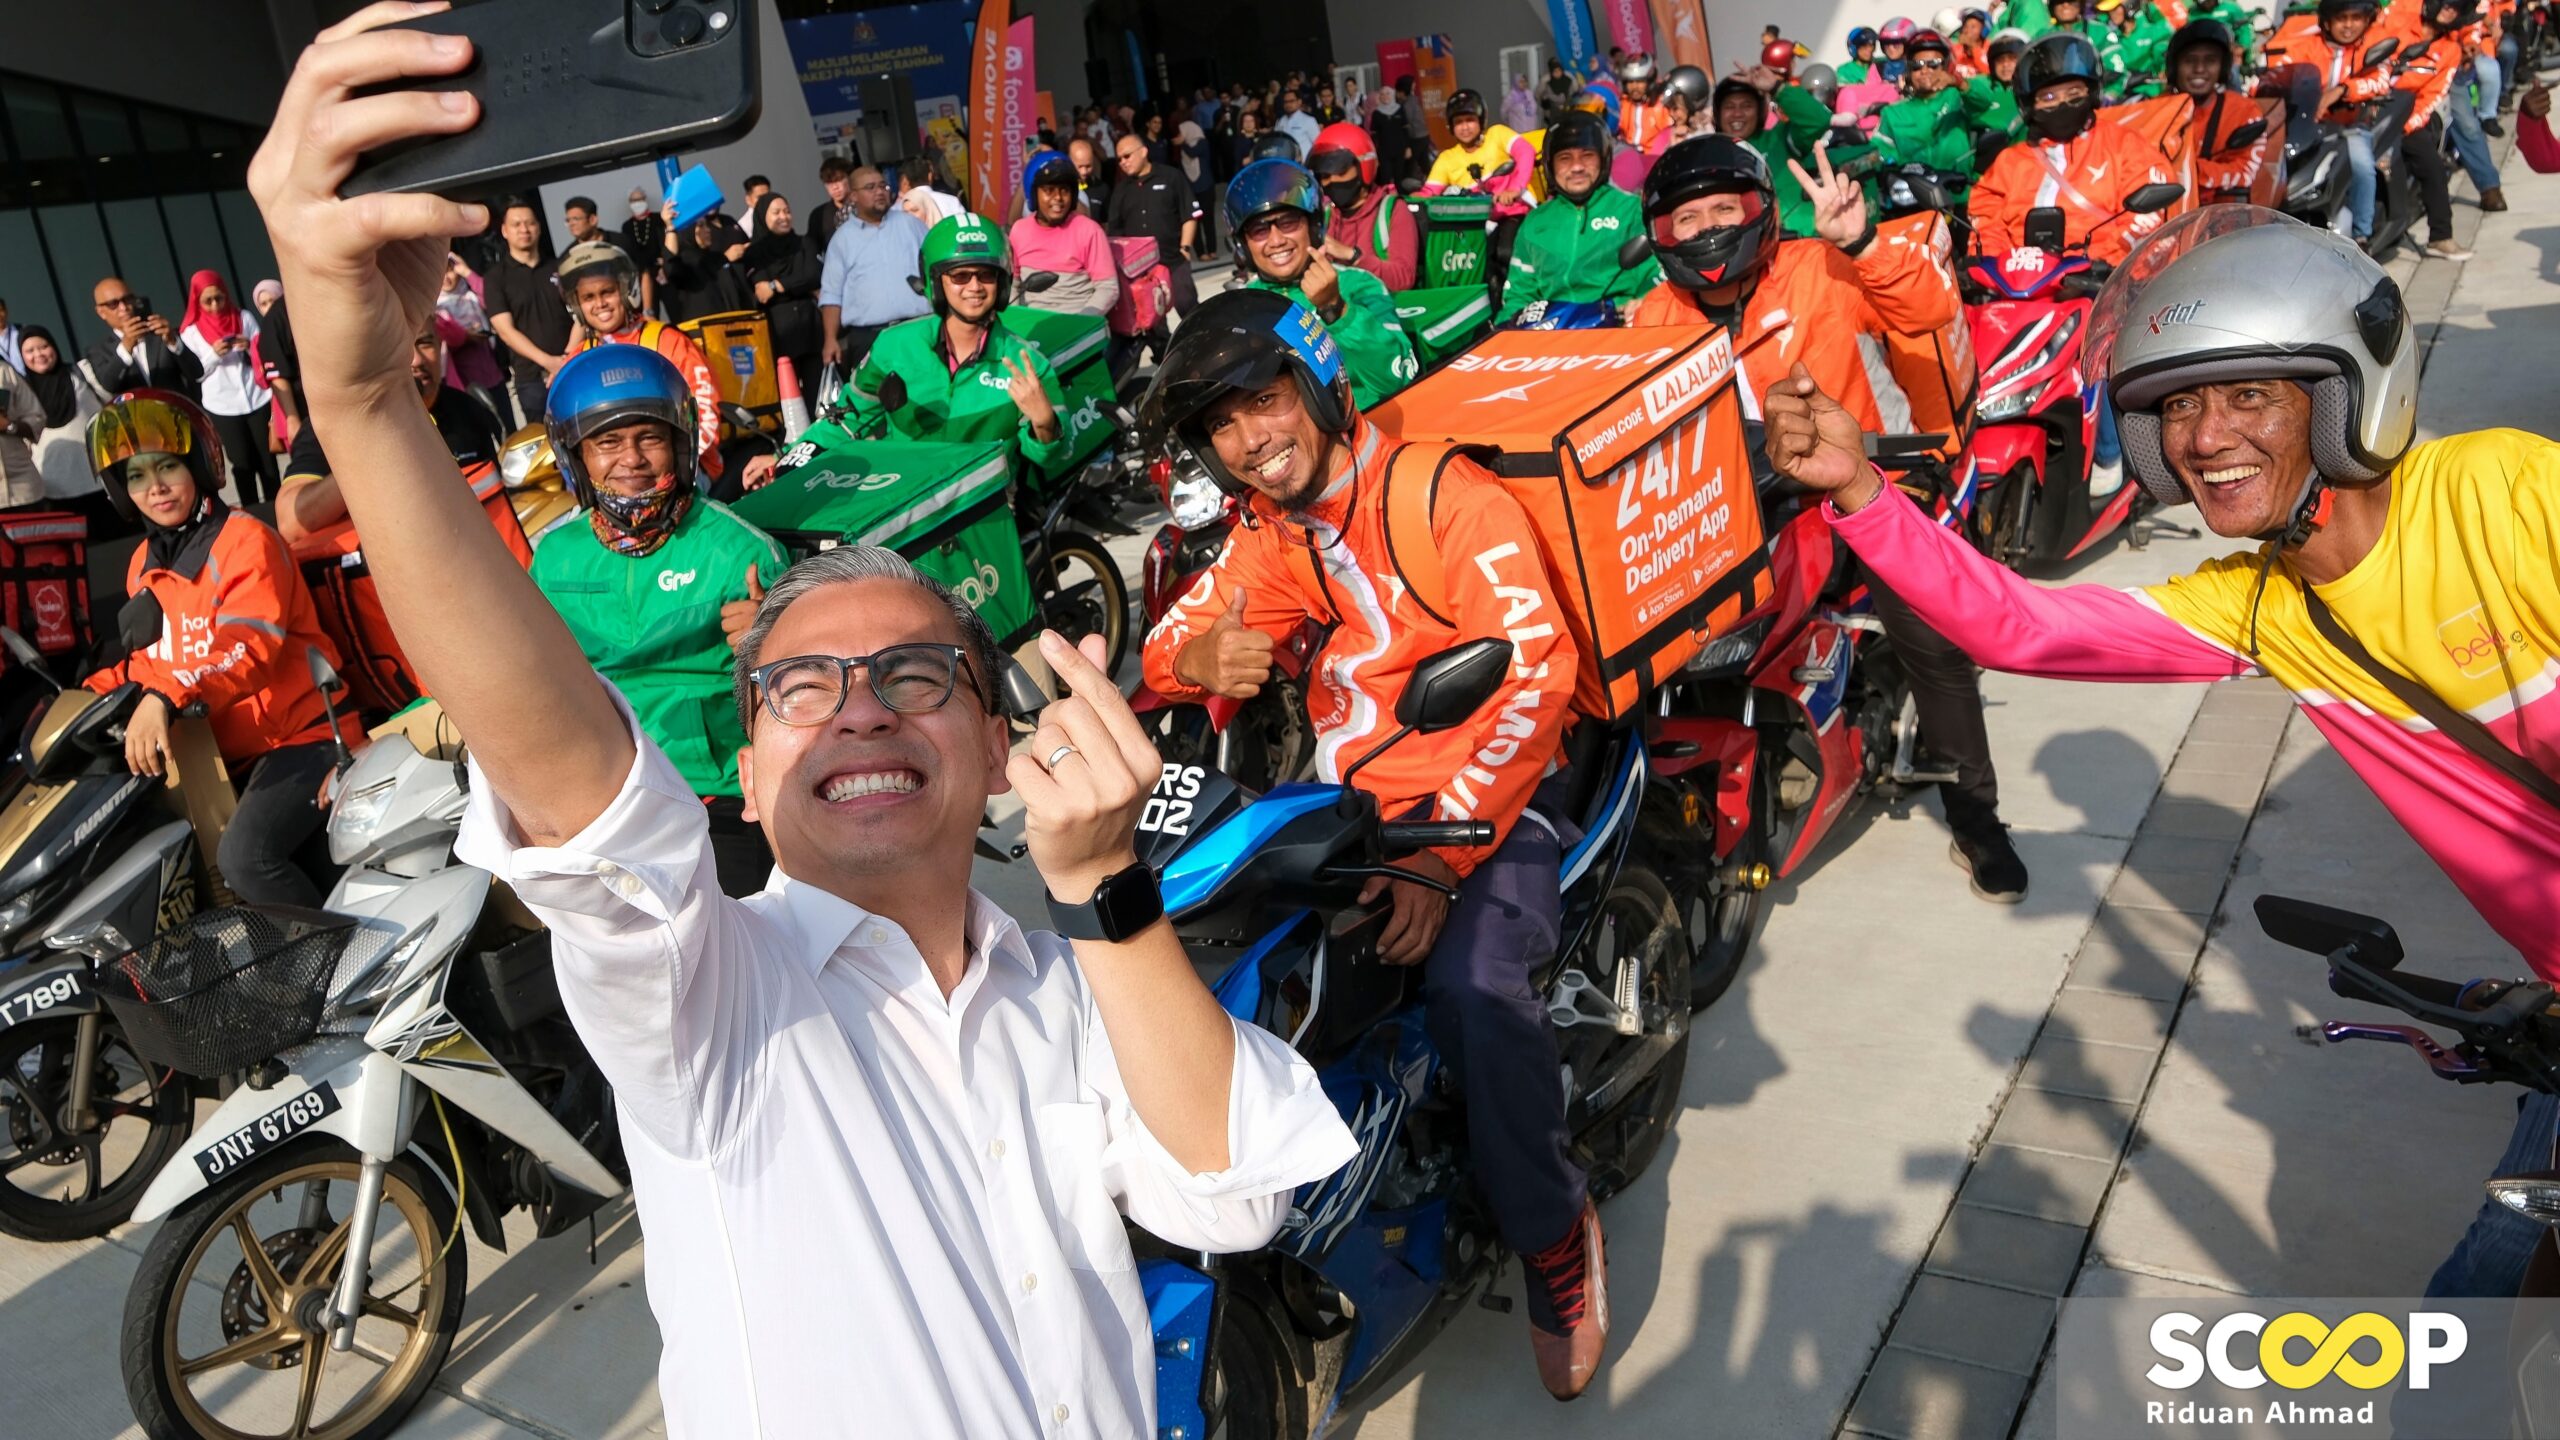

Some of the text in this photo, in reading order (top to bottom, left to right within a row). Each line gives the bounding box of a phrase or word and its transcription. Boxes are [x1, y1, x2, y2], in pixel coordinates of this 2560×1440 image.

[806, 45, 929, 70] MAJLIS PELANCARAN
[893, 54, 944, 72] RAHMAH
[955, 231, 988, 243] Grab
[601, 367, 643, 386] INDEX
[1449, 347, 1676, 372] LALAMOVE
[1576, 343, 1730, 464] COUPON CODE LALALAH
[1607, 405, 1709, 531] 24/7
[1620, 466, 1723, 565] On-Demand
[1625, 528, 1697, 595] Delivery
[1699, 503, 1731, 543] App
[1151, 762, 1206, 799] RS
[1134, 798, 1194, 836] 02
[13, 973, 82, 1018] 7891
[207, 1091, 325, 1175] JNF 6769
